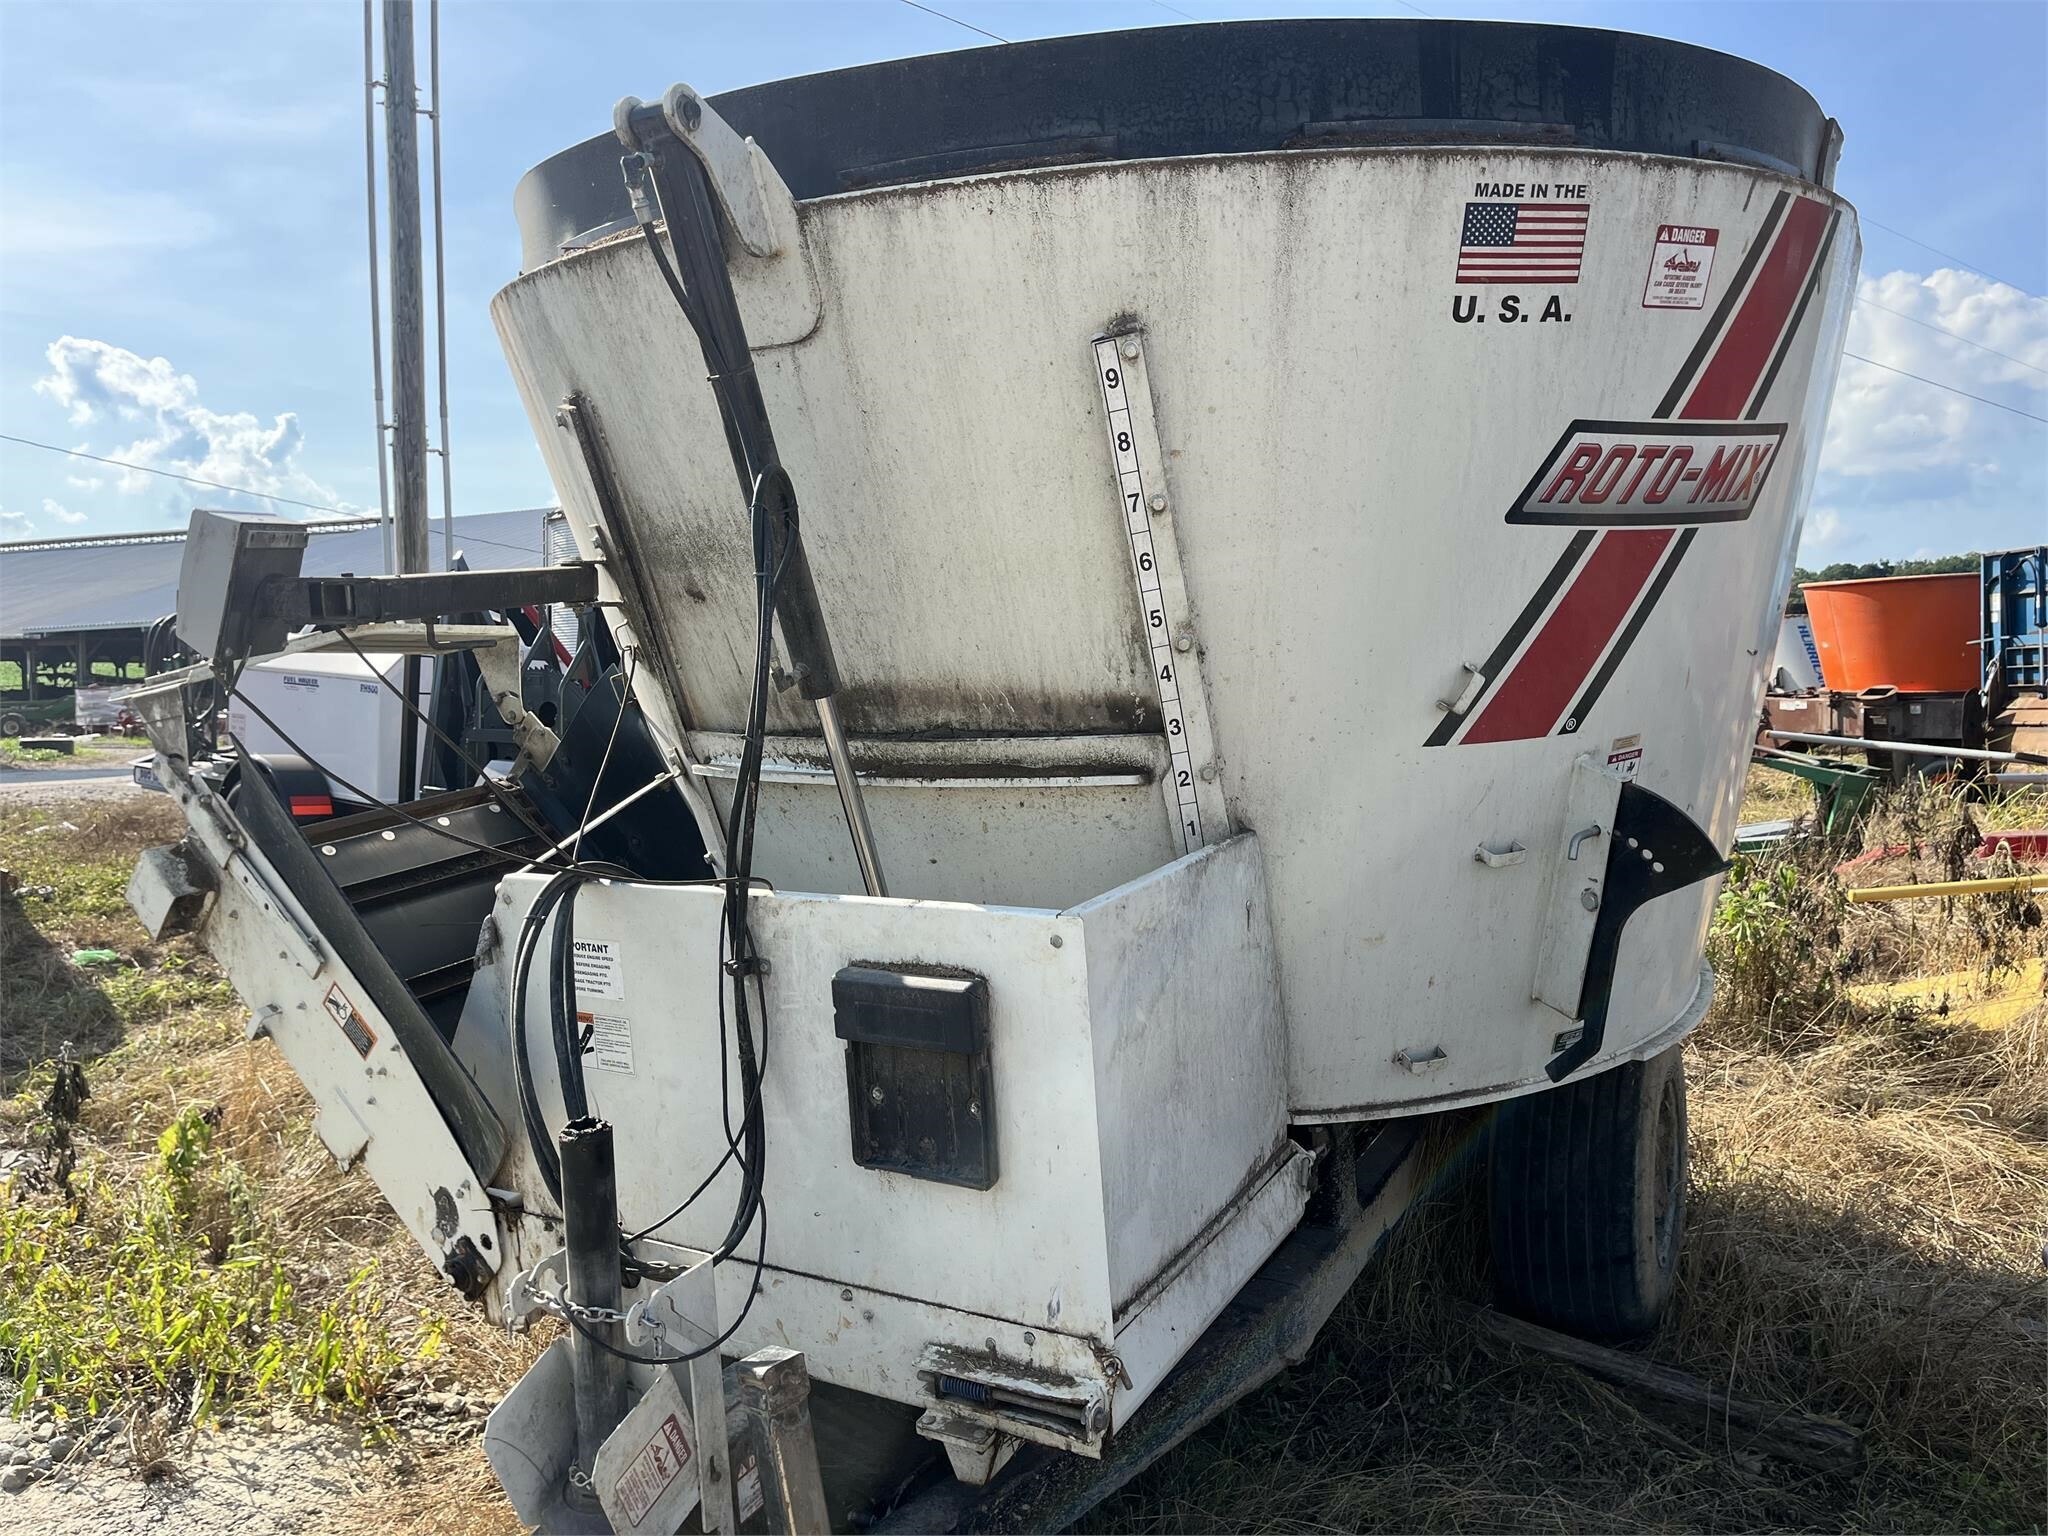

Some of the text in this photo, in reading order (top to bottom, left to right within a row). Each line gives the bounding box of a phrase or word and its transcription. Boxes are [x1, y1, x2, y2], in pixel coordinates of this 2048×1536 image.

[1474, 182, 1587, 199] MADE IN THE
[1671, 228, 1706, 244] DANGER
[1452, 295, 1572, 323] U. S. A.
[1105, 368, 1120, 389] 9
[1117, 431, 1131, 452] 8
[1538, 442, 1774, 504] ROTO-MIX
[1127, 492, 1140, 513] 7
[1139, 552, 1153, 571] 6
[1150, 609, 1163, 628] 5
[283, 675, 297, 683] FUEL
[1160, 664, 1173, 683] 4
[1168, 718, 1182, 736] 3
[1618, 751, 1639, 760] DANGER
[1177, 770, 1191, 788] 2
[1186, 820, 1196, 837] 1
[574, 941, 609, 954] ORTANT
[669, 1430, 688, 1464] DANGER
